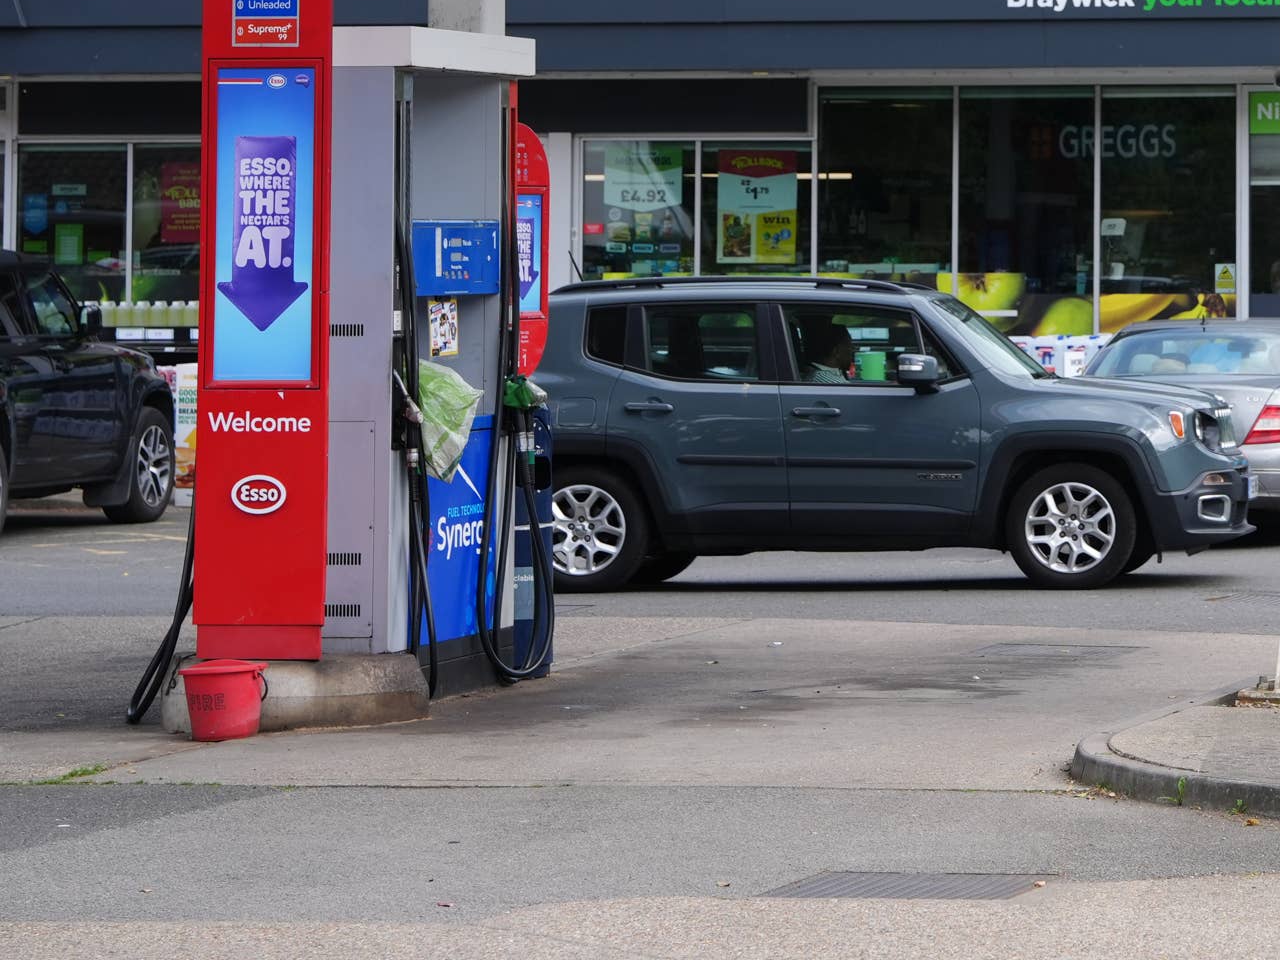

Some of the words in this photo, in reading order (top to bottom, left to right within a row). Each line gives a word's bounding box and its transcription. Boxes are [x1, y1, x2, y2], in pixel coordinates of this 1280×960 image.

[248, 0, 291, 9] Unleaded
[278, 33, 288, 41] 99
[1059, 126, 1176, 158] GREGGS
[241, 157, 293, 176] ESSO.
[240, 176, 290, 189] WHERE
[239, 189, 290, 215] THE
[241, 215, 290, 226] NECTAR'S
[235, 226, 292, 268] AT.
[492, 231, 497, 249] 1
[208, 411, 311, 432] Welcome
[240, 484, 278, 501] Esso
[448, 506, 460, 518] FUEL
[437, 516, 484, 560] Synerg
